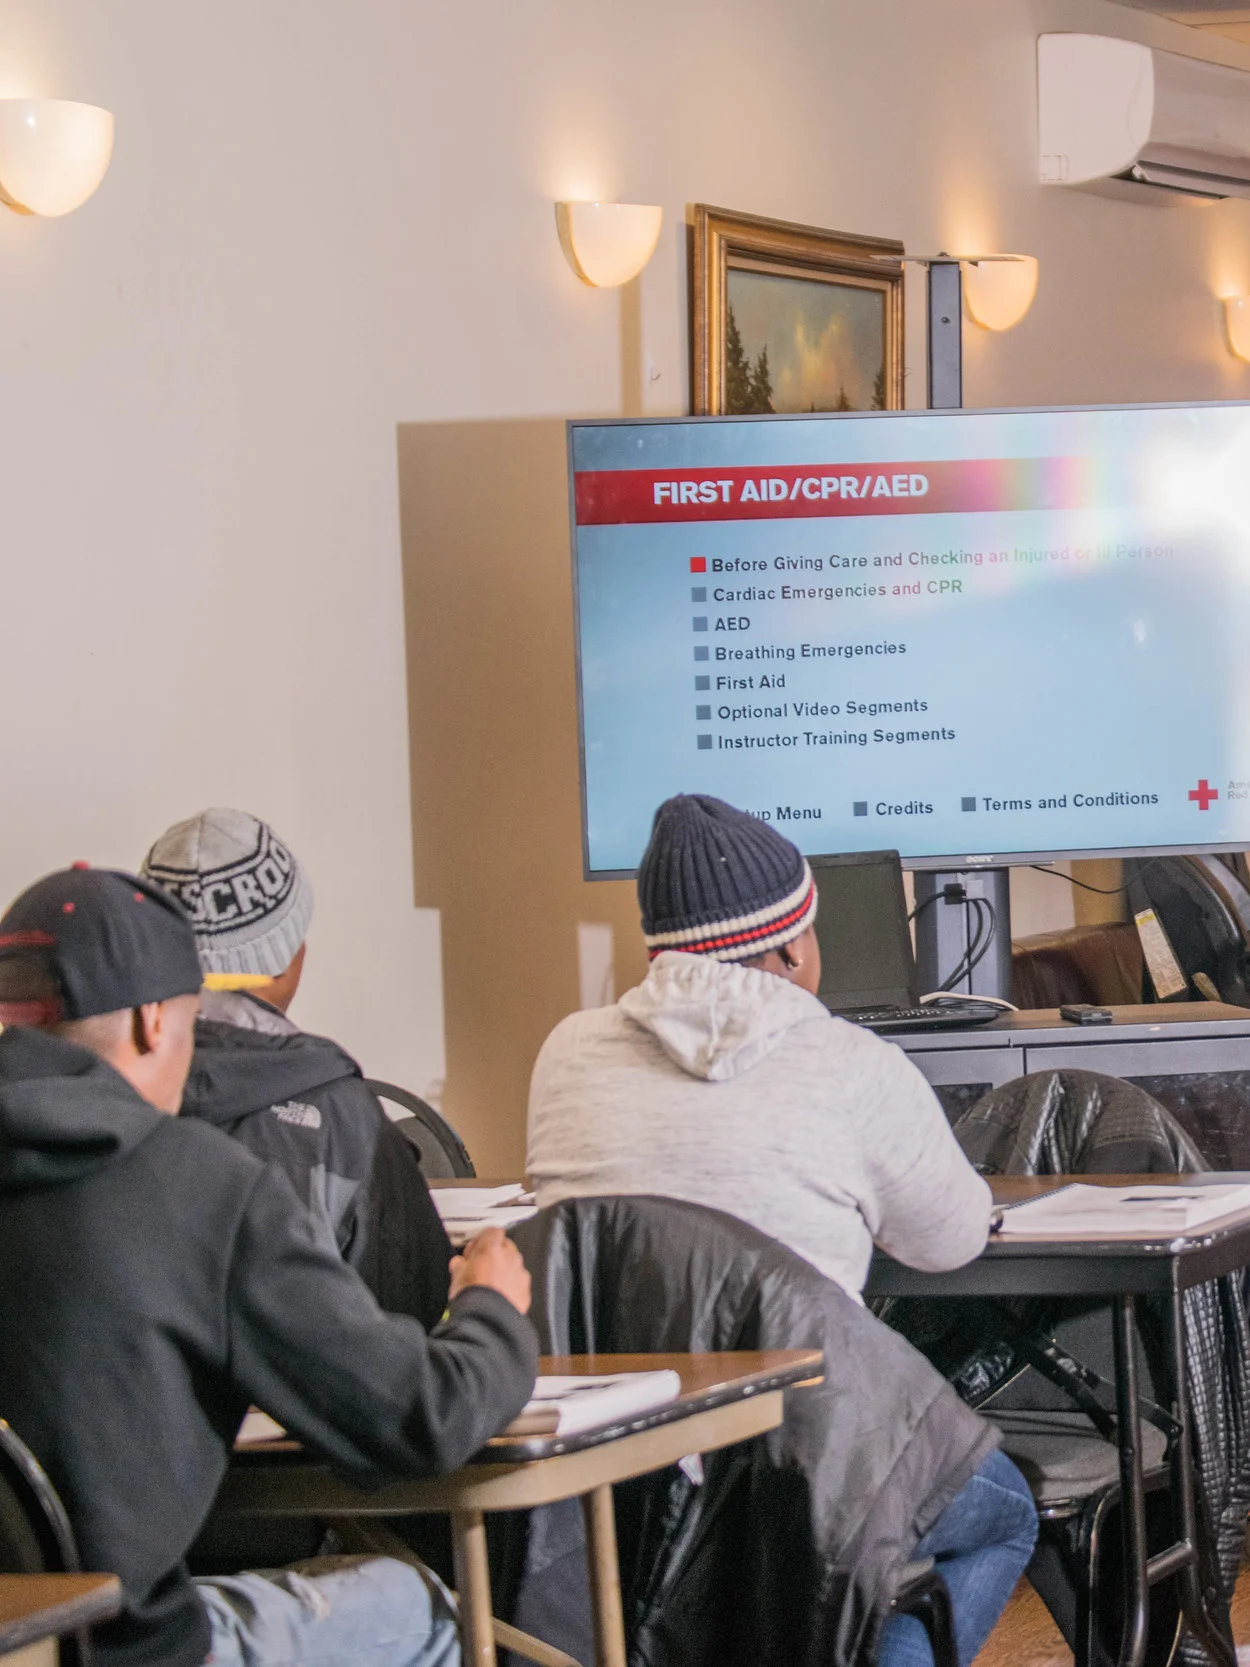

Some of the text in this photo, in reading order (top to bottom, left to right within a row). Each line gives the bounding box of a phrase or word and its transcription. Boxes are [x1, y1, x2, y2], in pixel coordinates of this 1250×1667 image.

[653, 474, 929, 505] FIRST AID/CPR/AED
[712, 558, 768, 572] Before
[774, 555, 823, 571] Giving
[830, 554, 867, 568] Care
[873, 552, 903, 567] and
[908, 550, 983, 566] Checking
[989, 551, 1009, 563] an
[1014, 547, 1070, 564] Injured
[1116, 545, 1174, 559] Person
[713, 580, 962, 601] Cardiac Emergencies and CPR
[714, 617, 750, 632] AED
[715, 641, 907, 661] Breathing Emergencies
[716, 674, 785, 690] First Aid
[718, 699, 928, 721] Optional Video Segments
[719, 727, 956, 749] Instructor Training Segments
[876, 801, 934, 816] Credits
[983, 791, 1159, 811] Terms and Conditions
[776, 806, 822, 820] Menu
